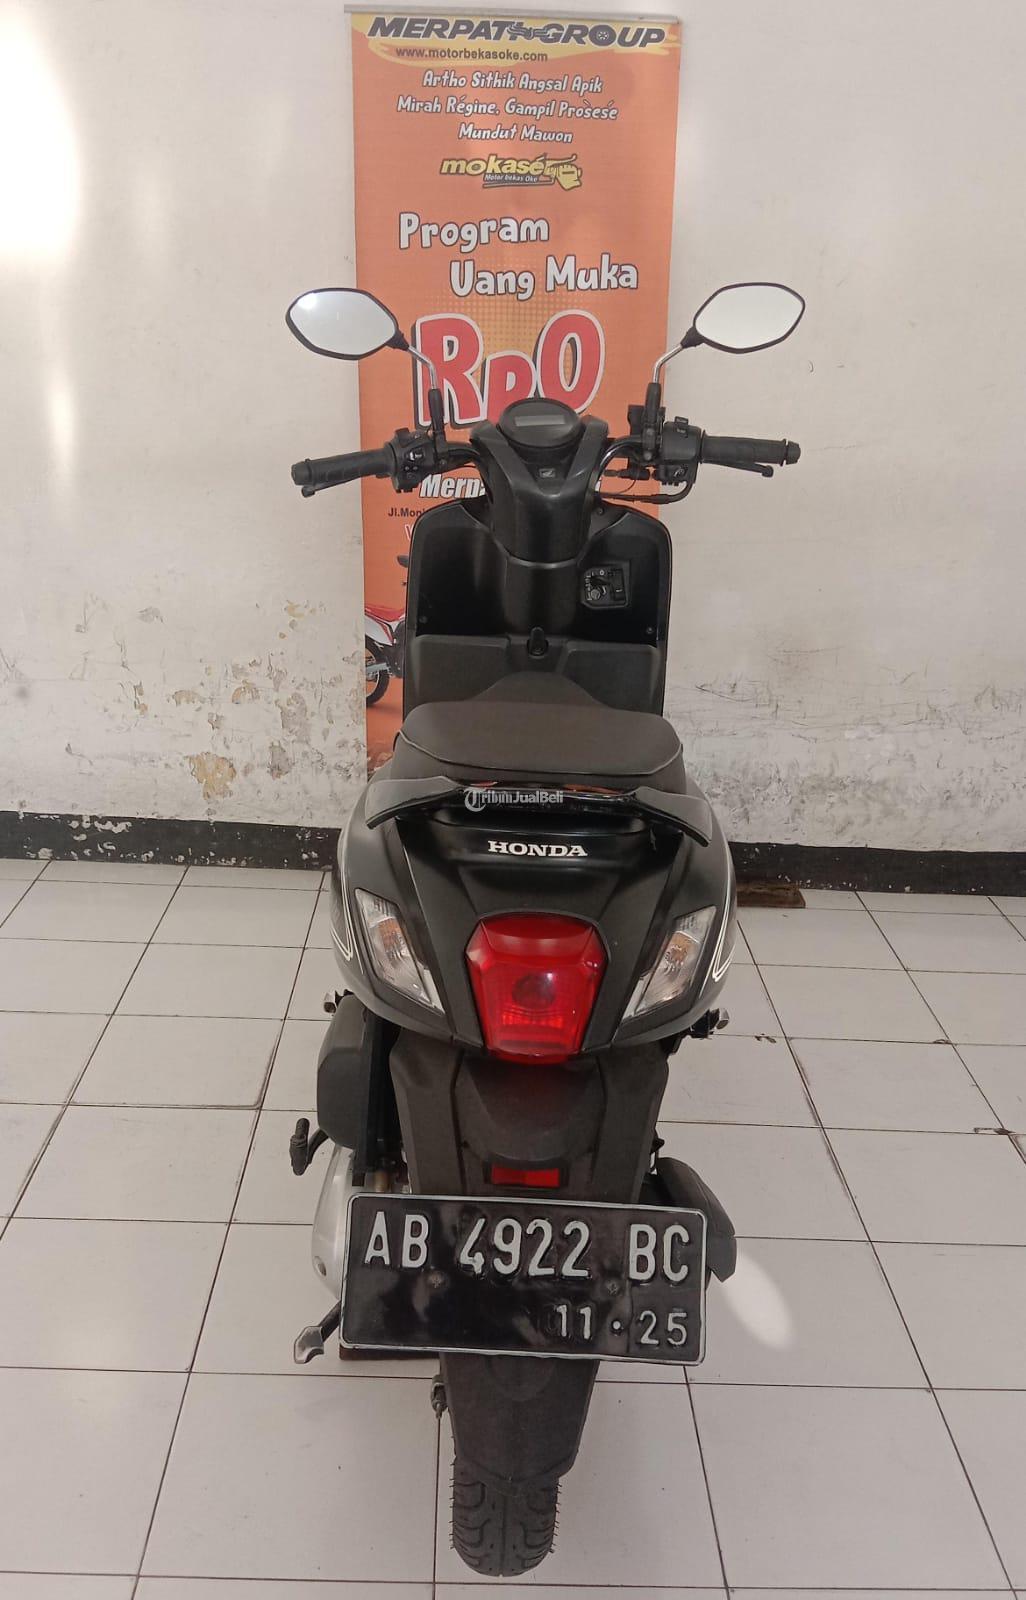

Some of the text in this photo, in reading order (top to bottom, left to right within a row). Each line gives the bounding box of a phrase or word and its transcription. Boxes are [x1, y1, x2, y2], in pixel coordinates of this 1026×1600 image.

[538, 23, 666, 47] GROUP
[395, 47, 548, 62] www.motorbekasoke.com
[423, 70, 603, 97] Artho Sithik Angsal Apik
[397, 95, 442, 114] Mirah
[505, 98, 555, 121] Gampil
[458, 122, 573, 143] Mundut Mawon
[399, 211, 550, 253] Program
[450, 253, 639, 301] Uang Muka
[487, 840, 588, 857] HONDA
[364, 1211, 690, 1282] AB 4922 BC
[636, 1310, 688, 1346] 25
